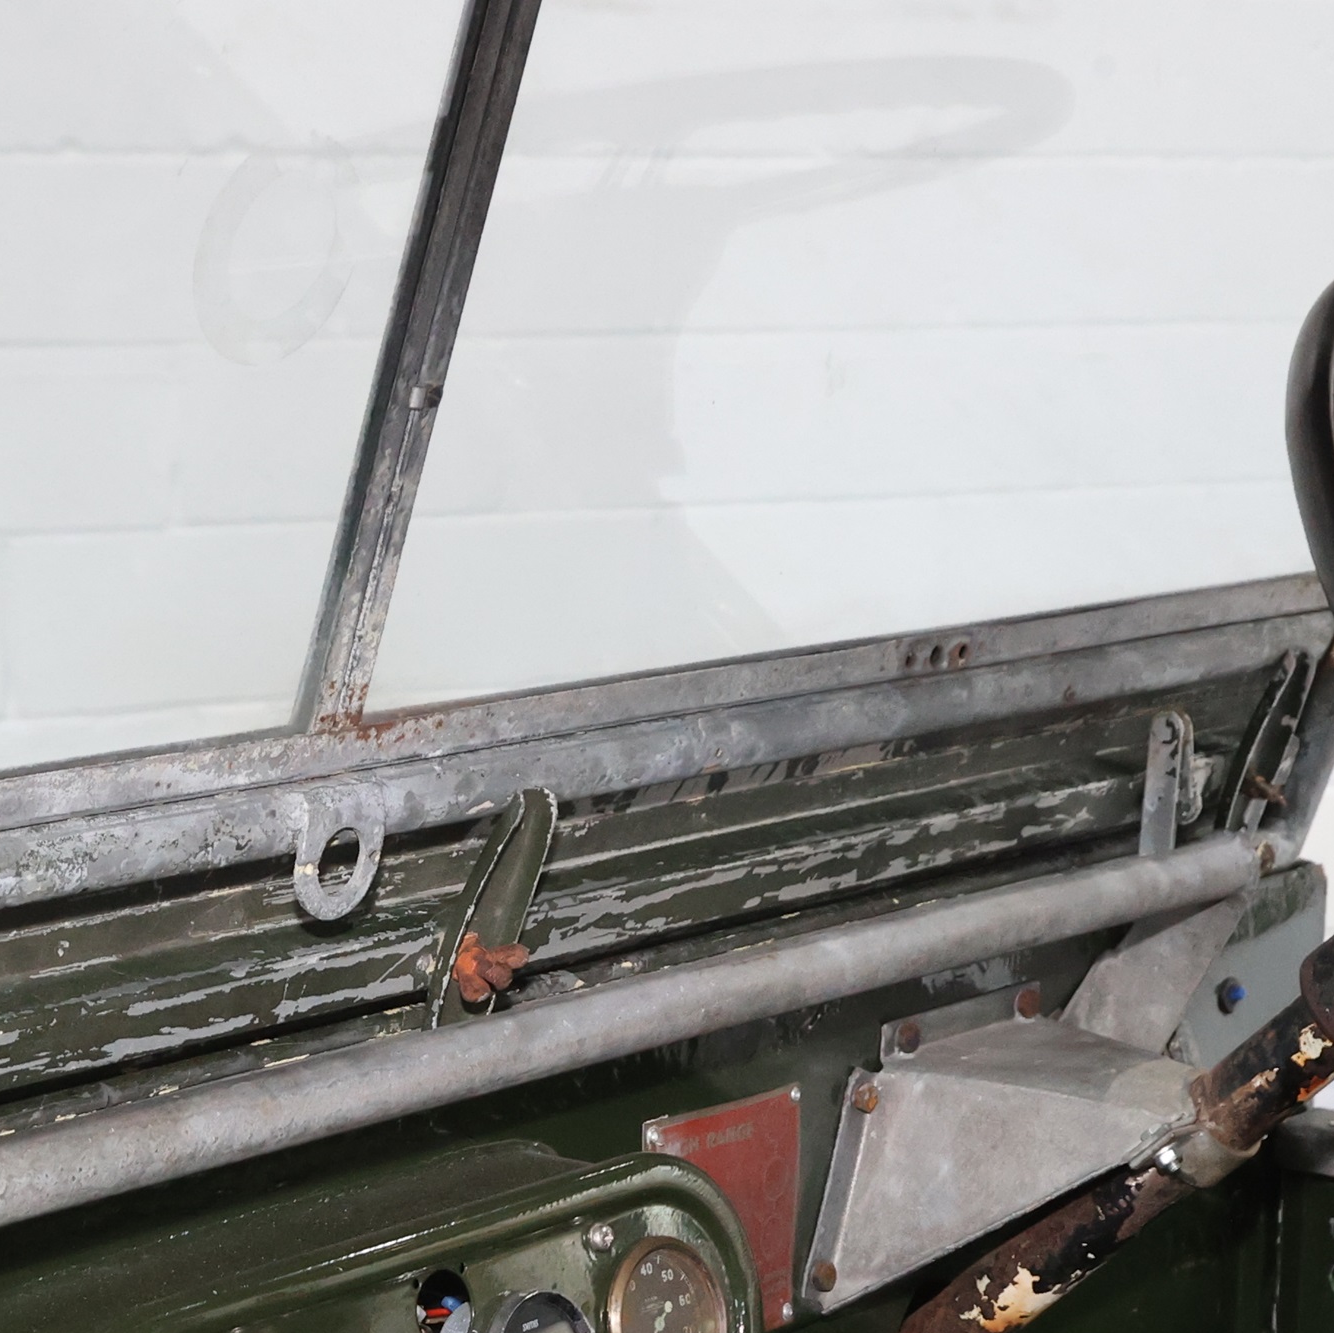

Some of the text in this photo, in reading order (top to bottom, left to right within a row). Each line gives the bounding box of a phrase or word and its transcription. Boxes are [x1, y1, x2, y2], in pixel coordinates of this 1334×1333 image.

[640, 1262, 654, 1277] 40
[660, 1268, 674, 1284] 50
[678, 1293, 692, 1307] 60
